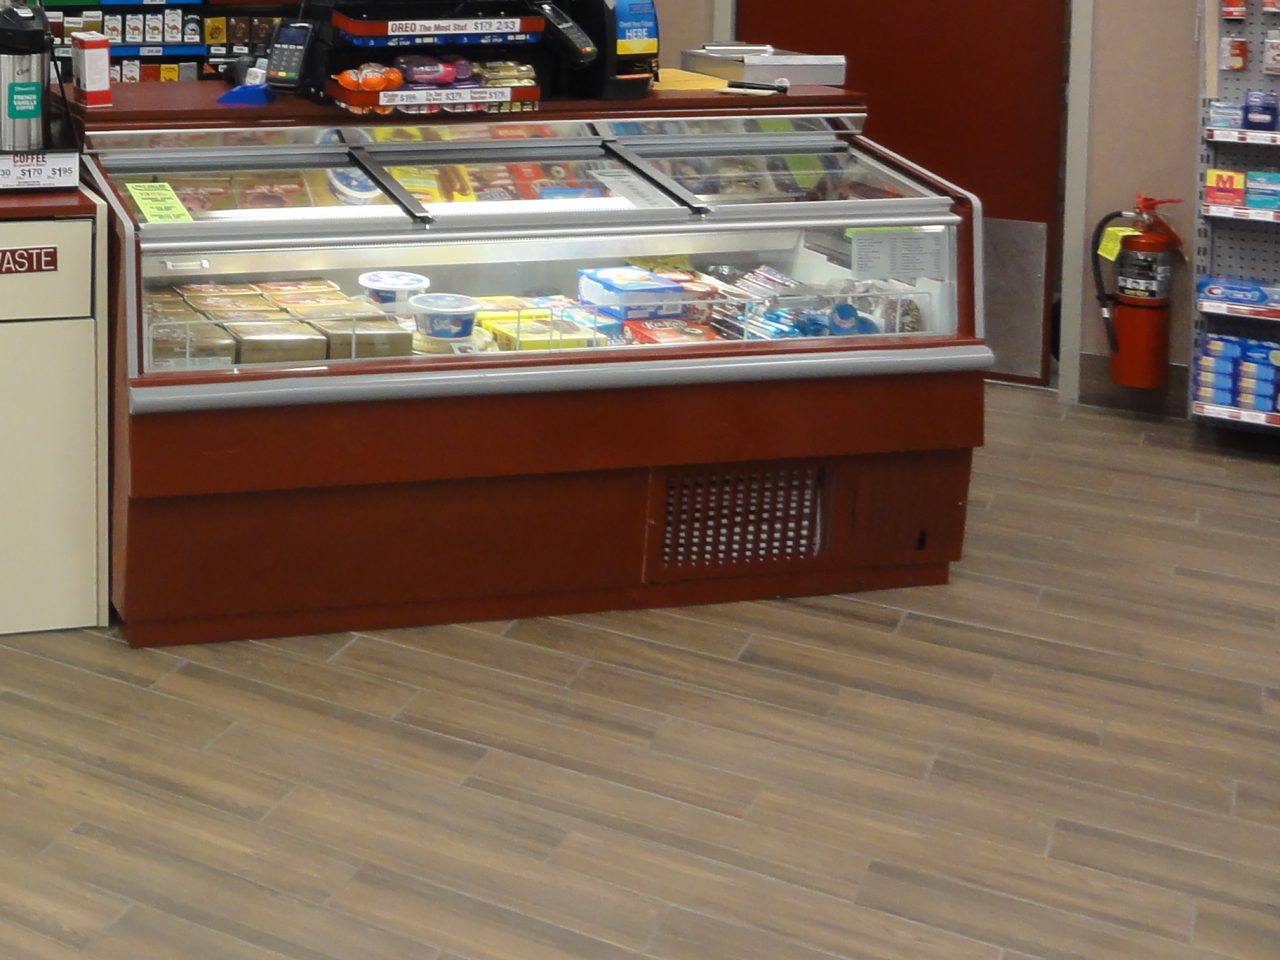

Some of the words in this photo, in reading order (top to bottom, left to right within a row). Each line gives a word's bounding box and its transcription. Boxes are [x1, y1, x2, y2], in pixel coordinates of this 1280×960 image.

[391, 22, 416, 32] OREO
[434, 23, 450, 31] Most
[625, 28, 648, 40] HERE
[13, 153, 48, 164] COFFEE
